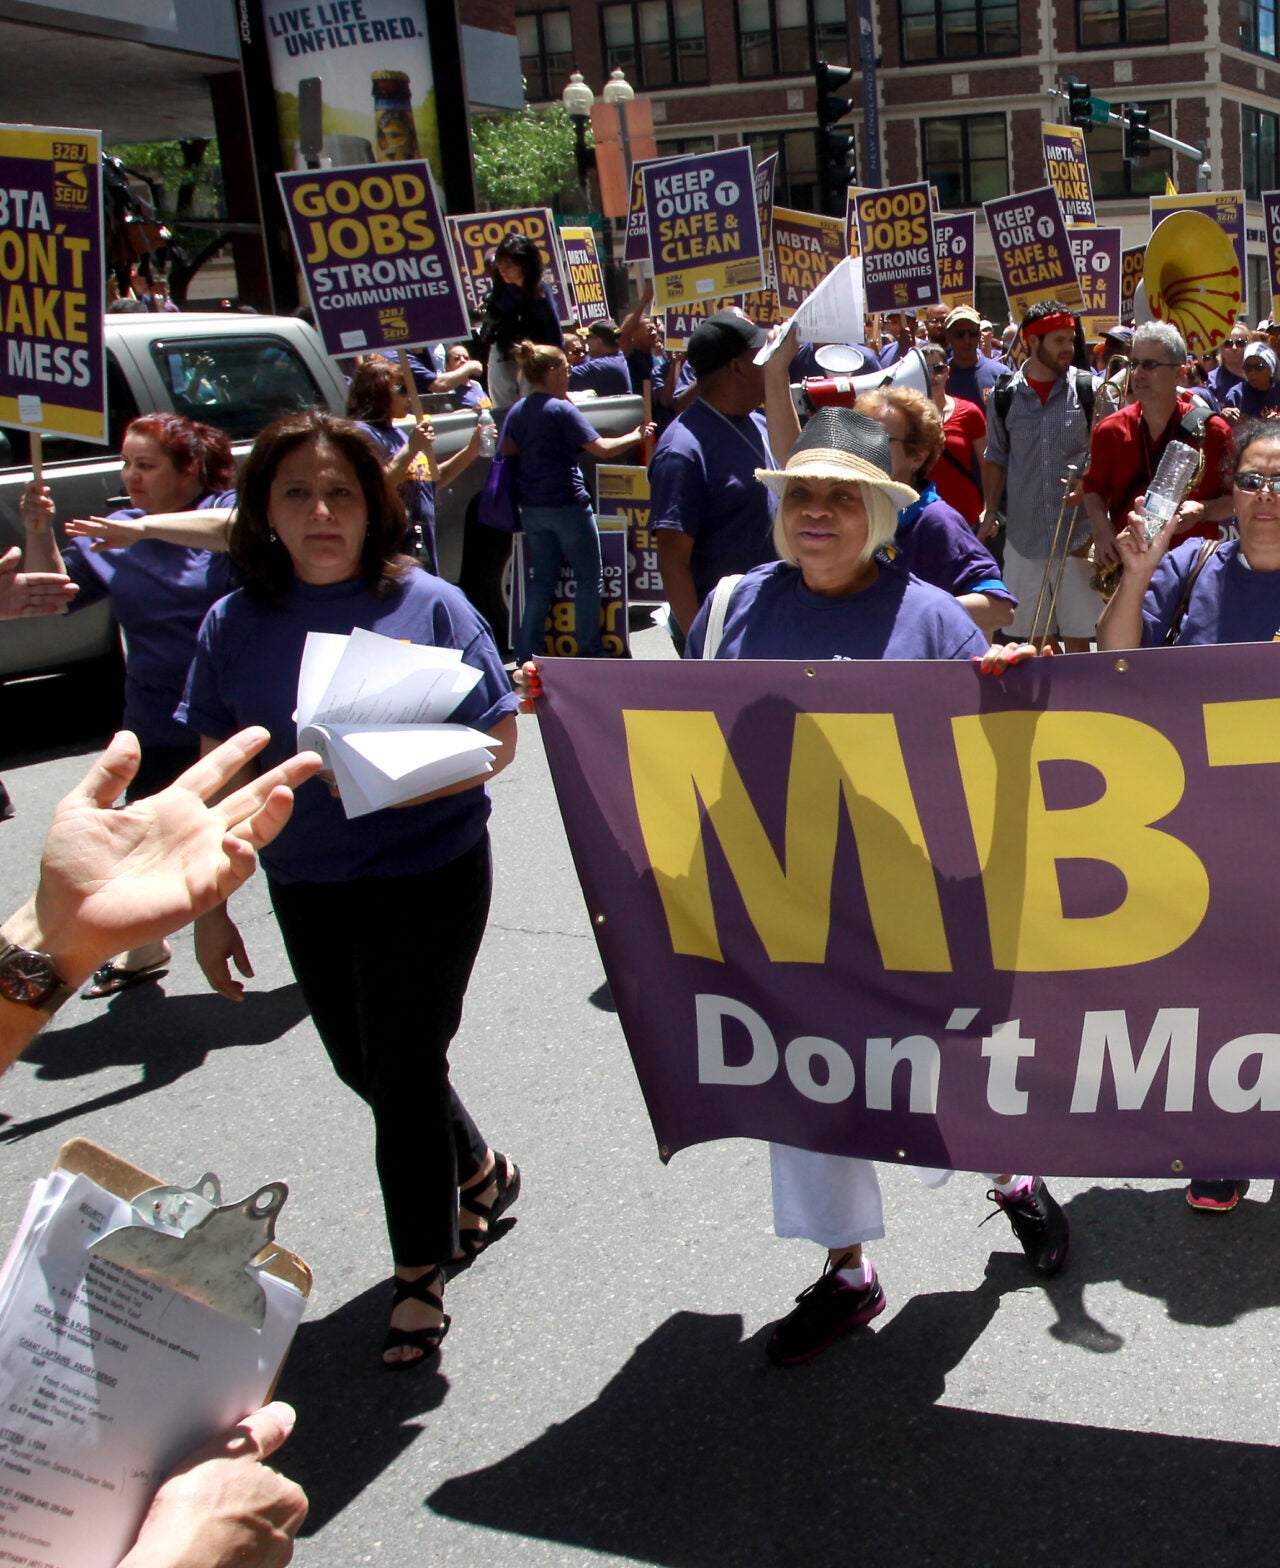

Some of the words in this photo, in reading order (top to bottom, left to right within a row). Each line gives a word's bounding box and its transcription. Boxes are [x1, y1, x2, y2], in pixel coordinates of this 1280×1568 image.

[268, 7, 315, 37] LIVE
[318, 0, 367, 26] LIFE
[284, 17, 424, 57] UNFILTERED.
[54, 144, 86, 161] 32BJ
[1047, 145, 1075, 162] MBTA
[1049, 159, 1086, 181] DON'T
[54, 187, 88, 203] SEIU
[292, 173, 426, 218] GOOD
[654, 168, 715, 198] KEEP
[0, 188, 51, 231] BTA
[657, 191, 709, 218] OUR
[860, 192, 927, 223] GOOD
[1066, 201, 1092, 215] MESS
[659, 212, 719, 242] SAFE
[724, 213, 739, 229] &
[993, 205, 1035, 231] KEEP
[307, 210, 435, 264] JOBS
[661, 231, 741, 263] CLEAN
[776, 230, 822, 253] MBTA
[863, 217, 928, 253] JOBS
[999, 225, 1035, 249] OUR
[0, 224, 90, 288] ON'T
[567, 250, 589, 265] MBTA
[865, 247, 930, 272] STRONG
[955, 260, 964, 270] &
[1003, 243, 1048, 268] SAFE
[1048, 245, 1058, 258] &
[312, 254, 444, 293] STRONG
[571, 261, 599, 284] DON'T
[866, 265, 932, 283] COMMUNITIES
[1009, 262, 1064, 287] CLEAN
[1096, 278, 1107, 291] &
[319, 280, 450, 310] COMMUNITIES
[576, 284, 603, 304] MAKE
[788, 286, 798, 302] A
[0, 284, 88, 343] AKE
[582, 306, 589, 319] A
[589, 303, 606, 318] MESS
[675, 317, 686, 331] A
[8, 339, 91, 387] MESS
[695, 994, 1036, 1115] Don't
